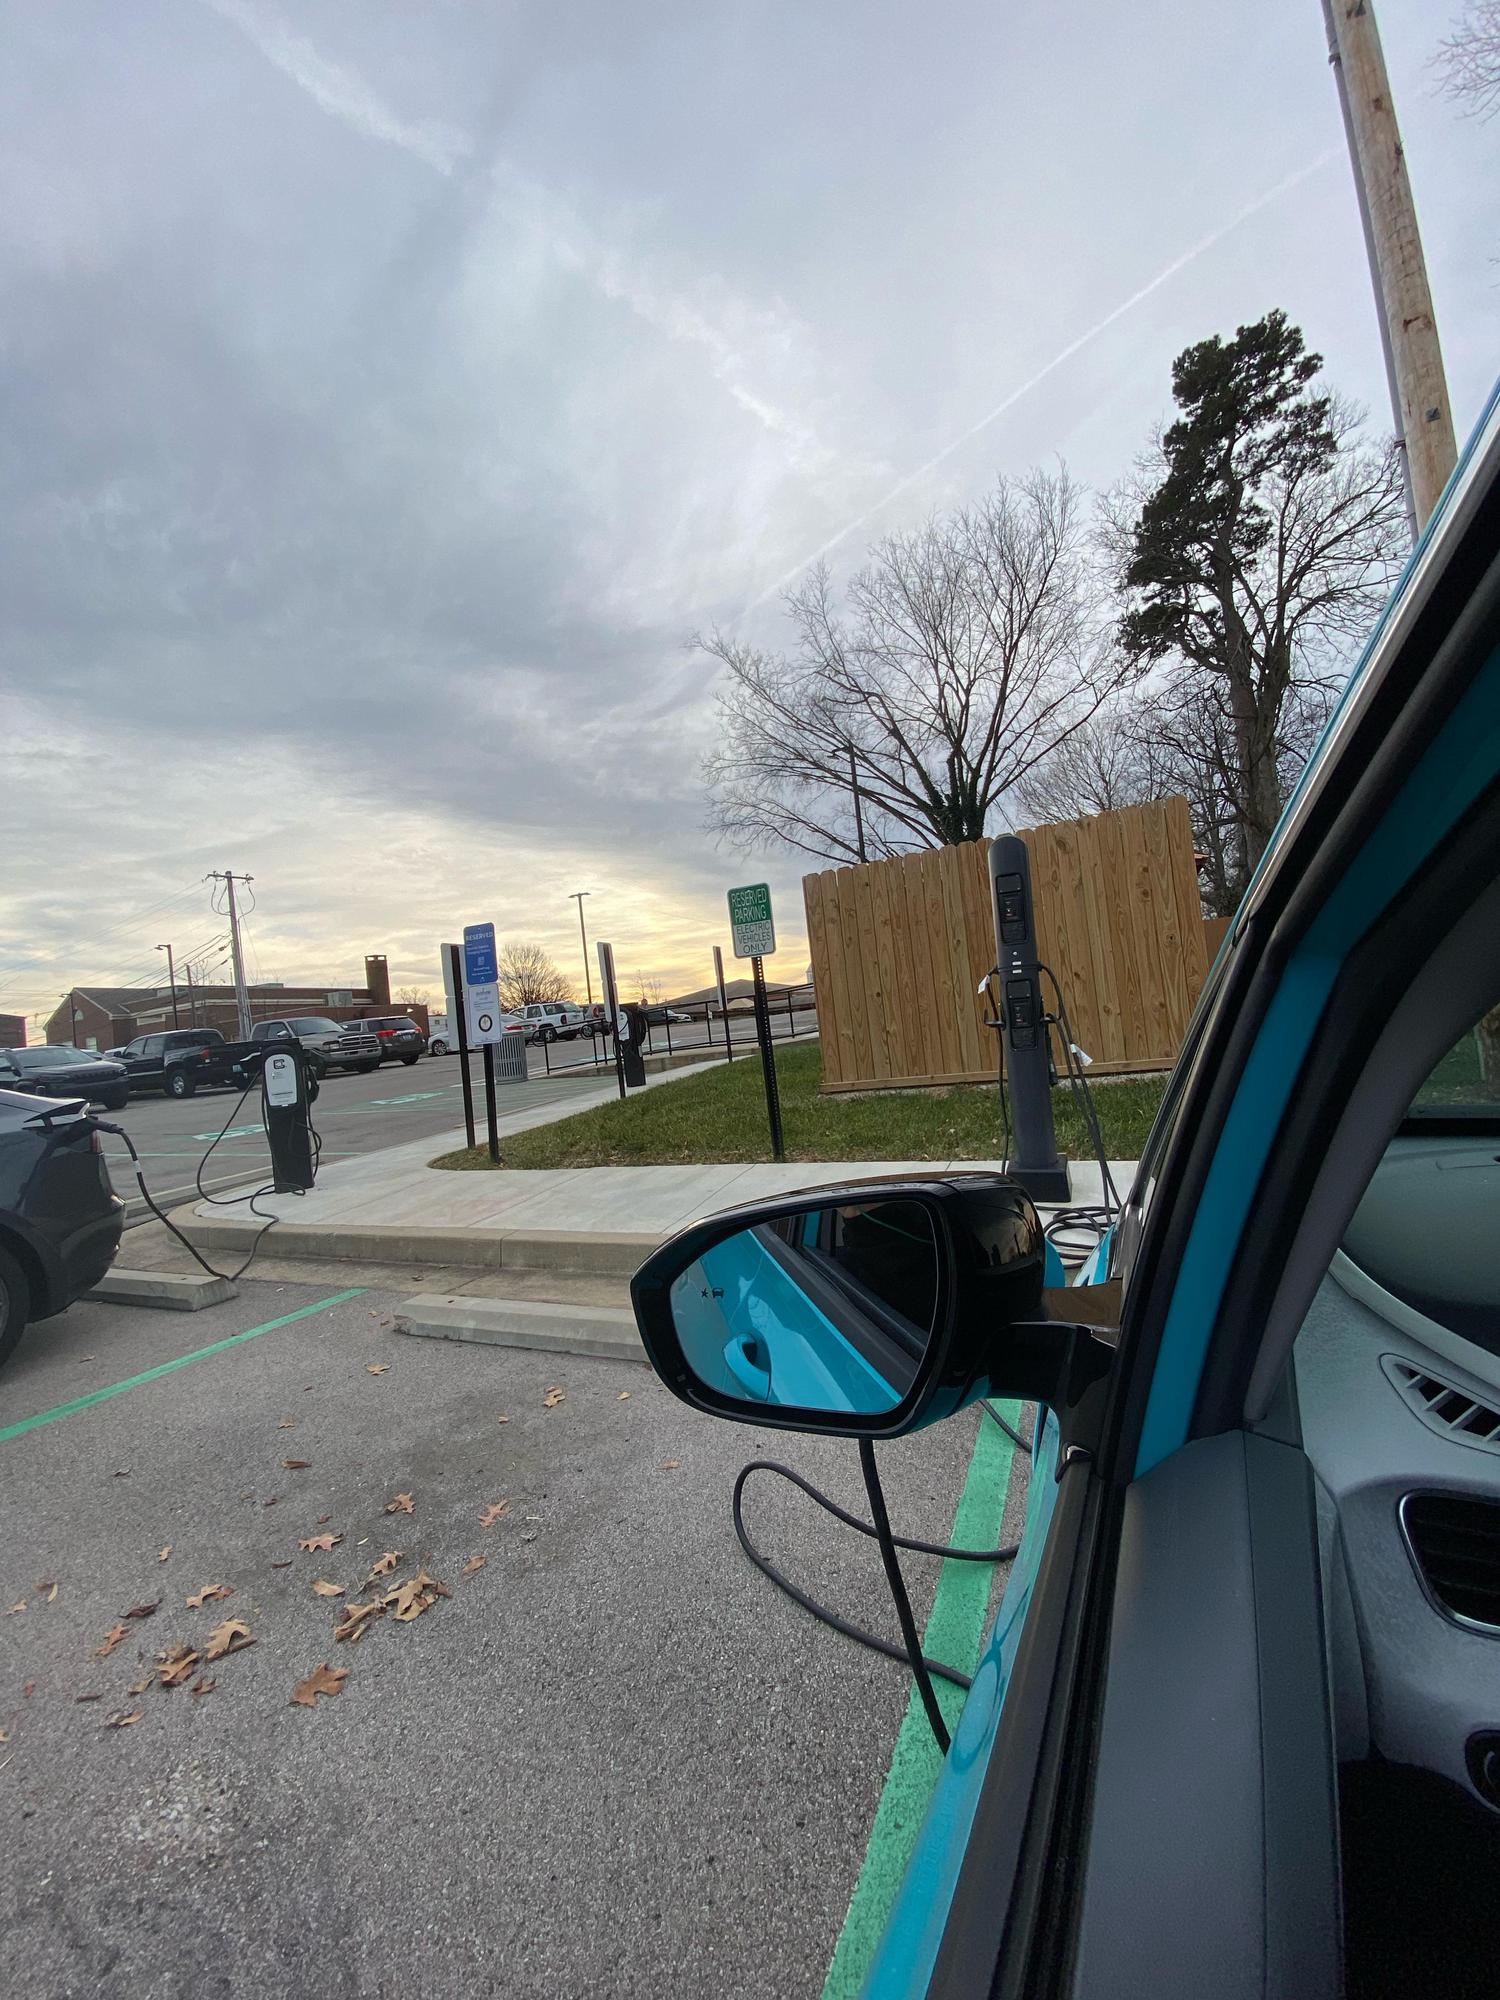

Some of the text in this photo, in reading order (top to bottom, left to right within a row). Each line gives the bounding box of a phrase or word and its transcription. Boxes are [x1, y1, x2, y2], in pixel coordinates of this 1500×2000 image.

[731, 888, 767, 907] RESERVED
[735, 904, 767, 922] PARKING
[736, 921, 770, 935] ELECTRIC
[738, 931, 771, 945] VEHICLES
[743, 942, 767, 953] ONLY
